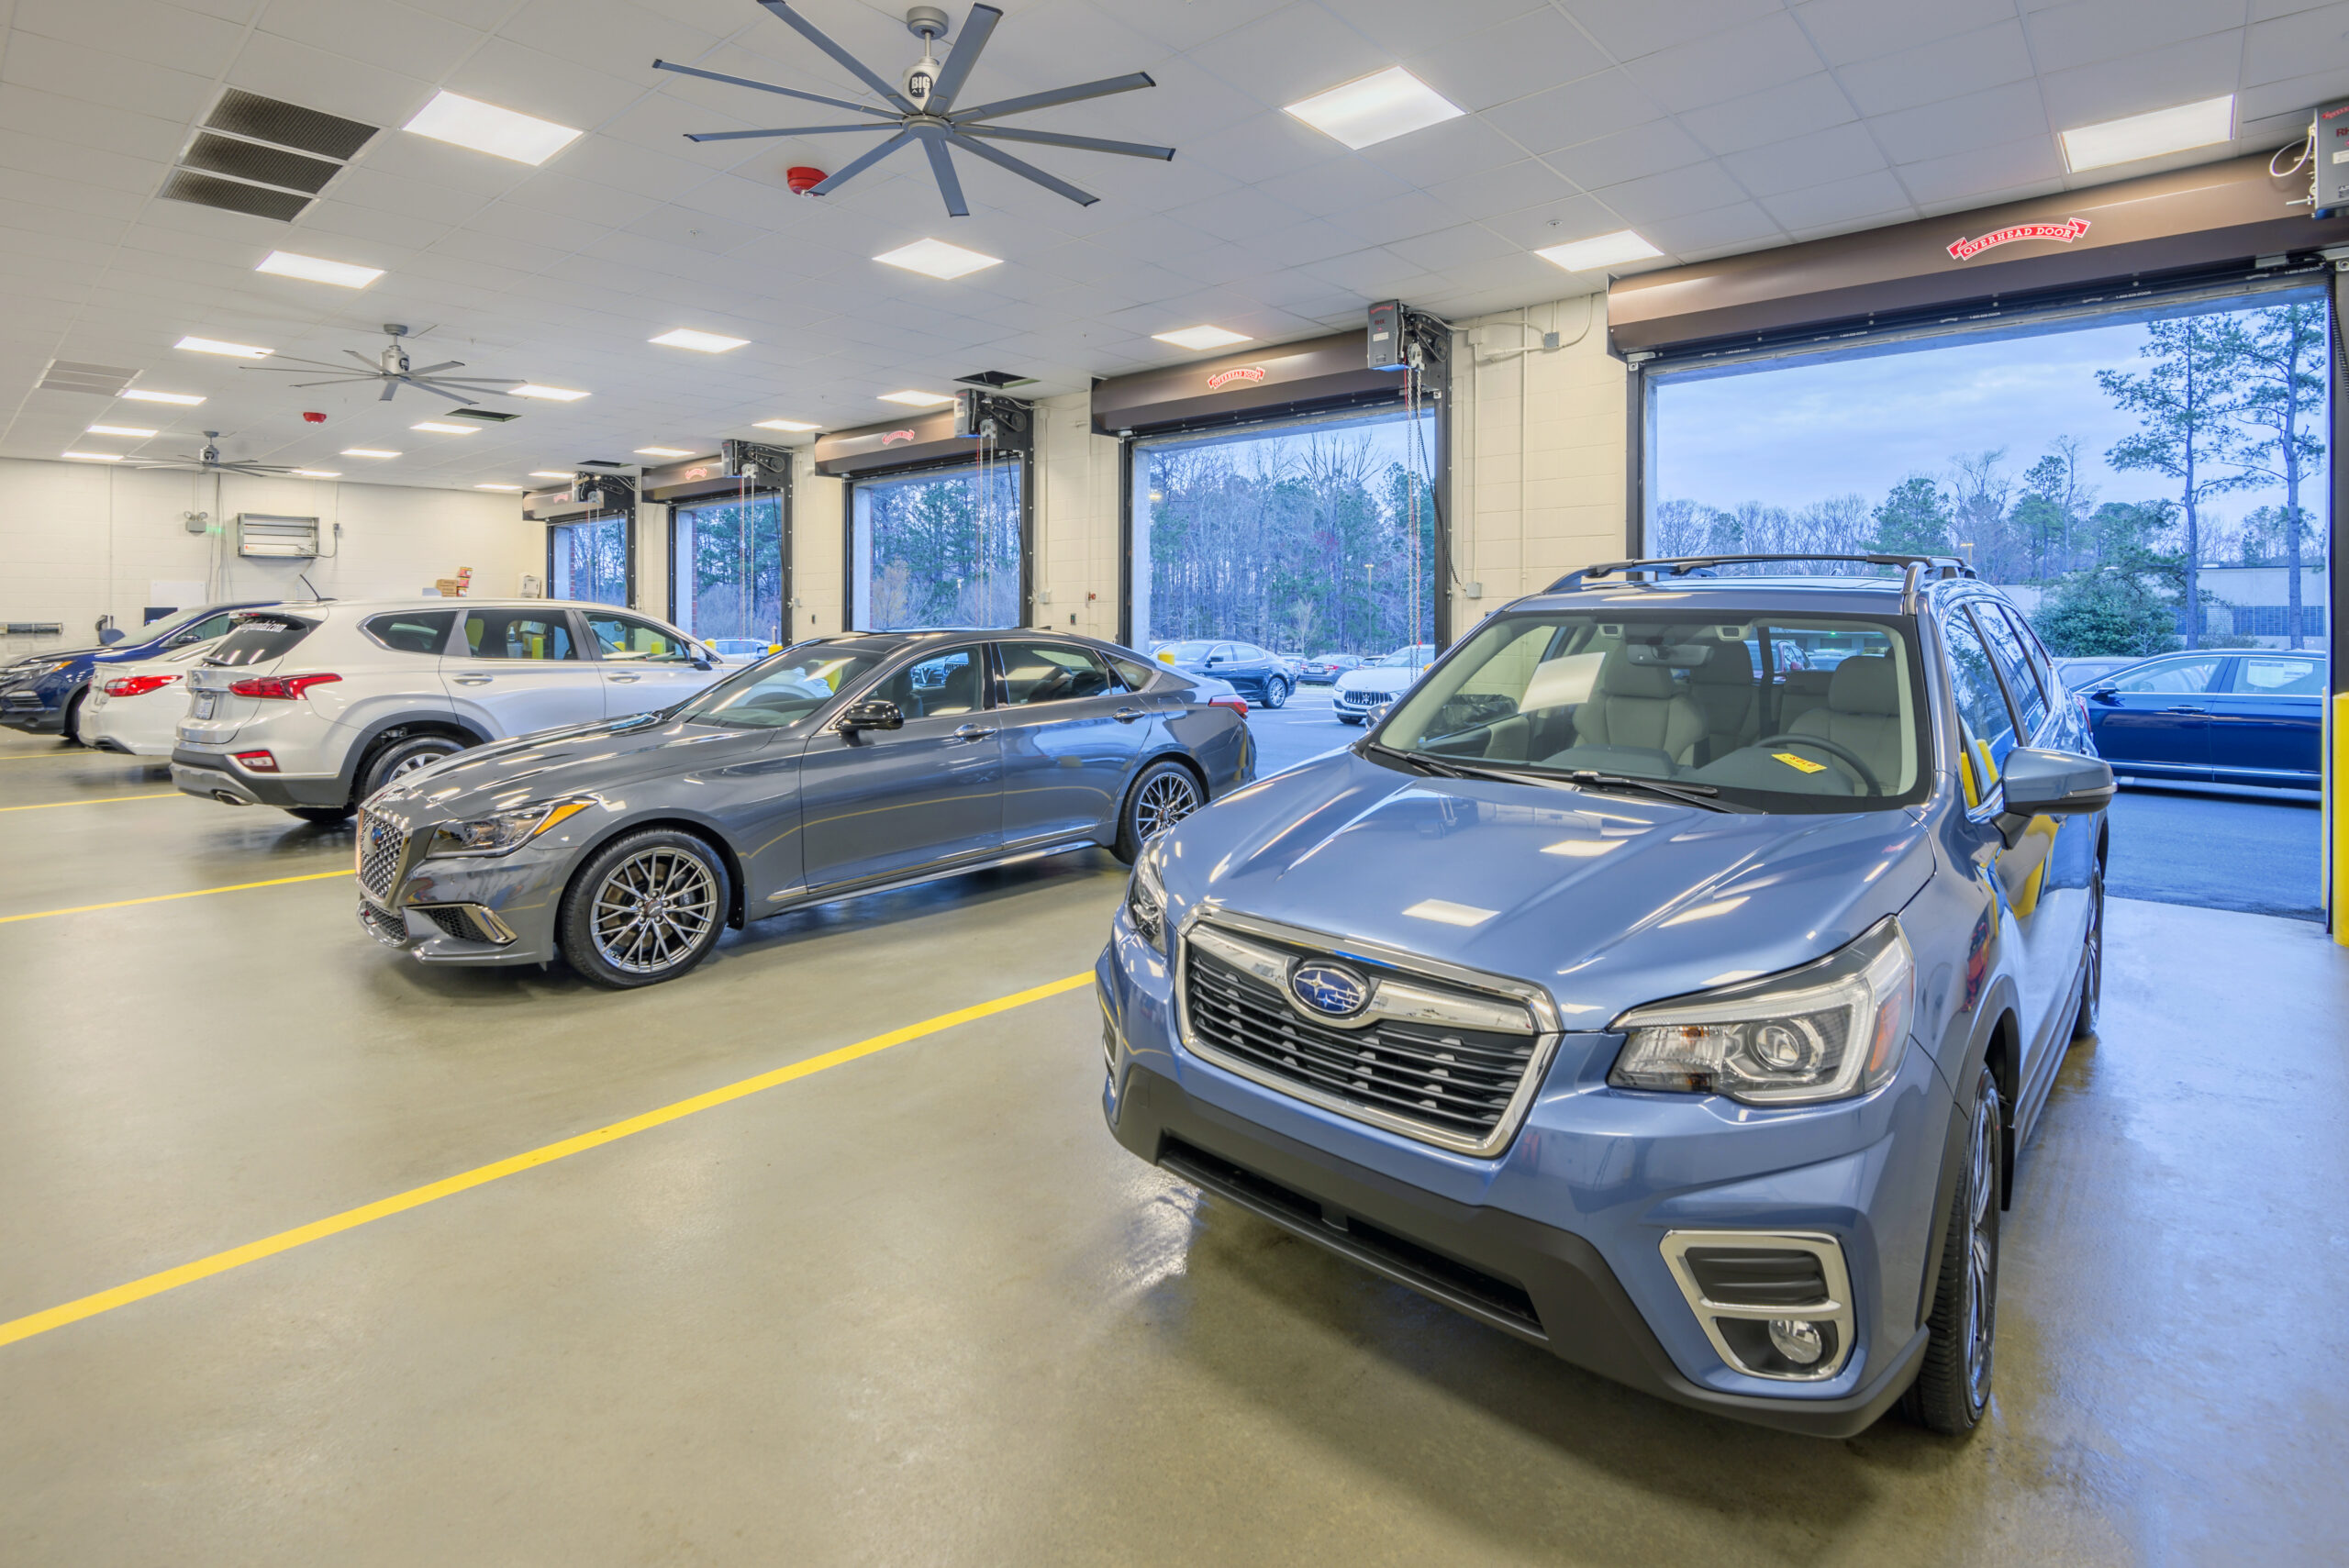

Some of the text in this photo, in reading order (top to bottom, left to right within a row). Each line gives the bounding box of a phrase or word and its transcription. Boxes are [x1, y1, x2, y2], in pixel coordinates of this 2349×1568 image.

[911, 76, 930, 88] BIG
[1964, 227, 2072, 255] OVERHEAD DOOR
